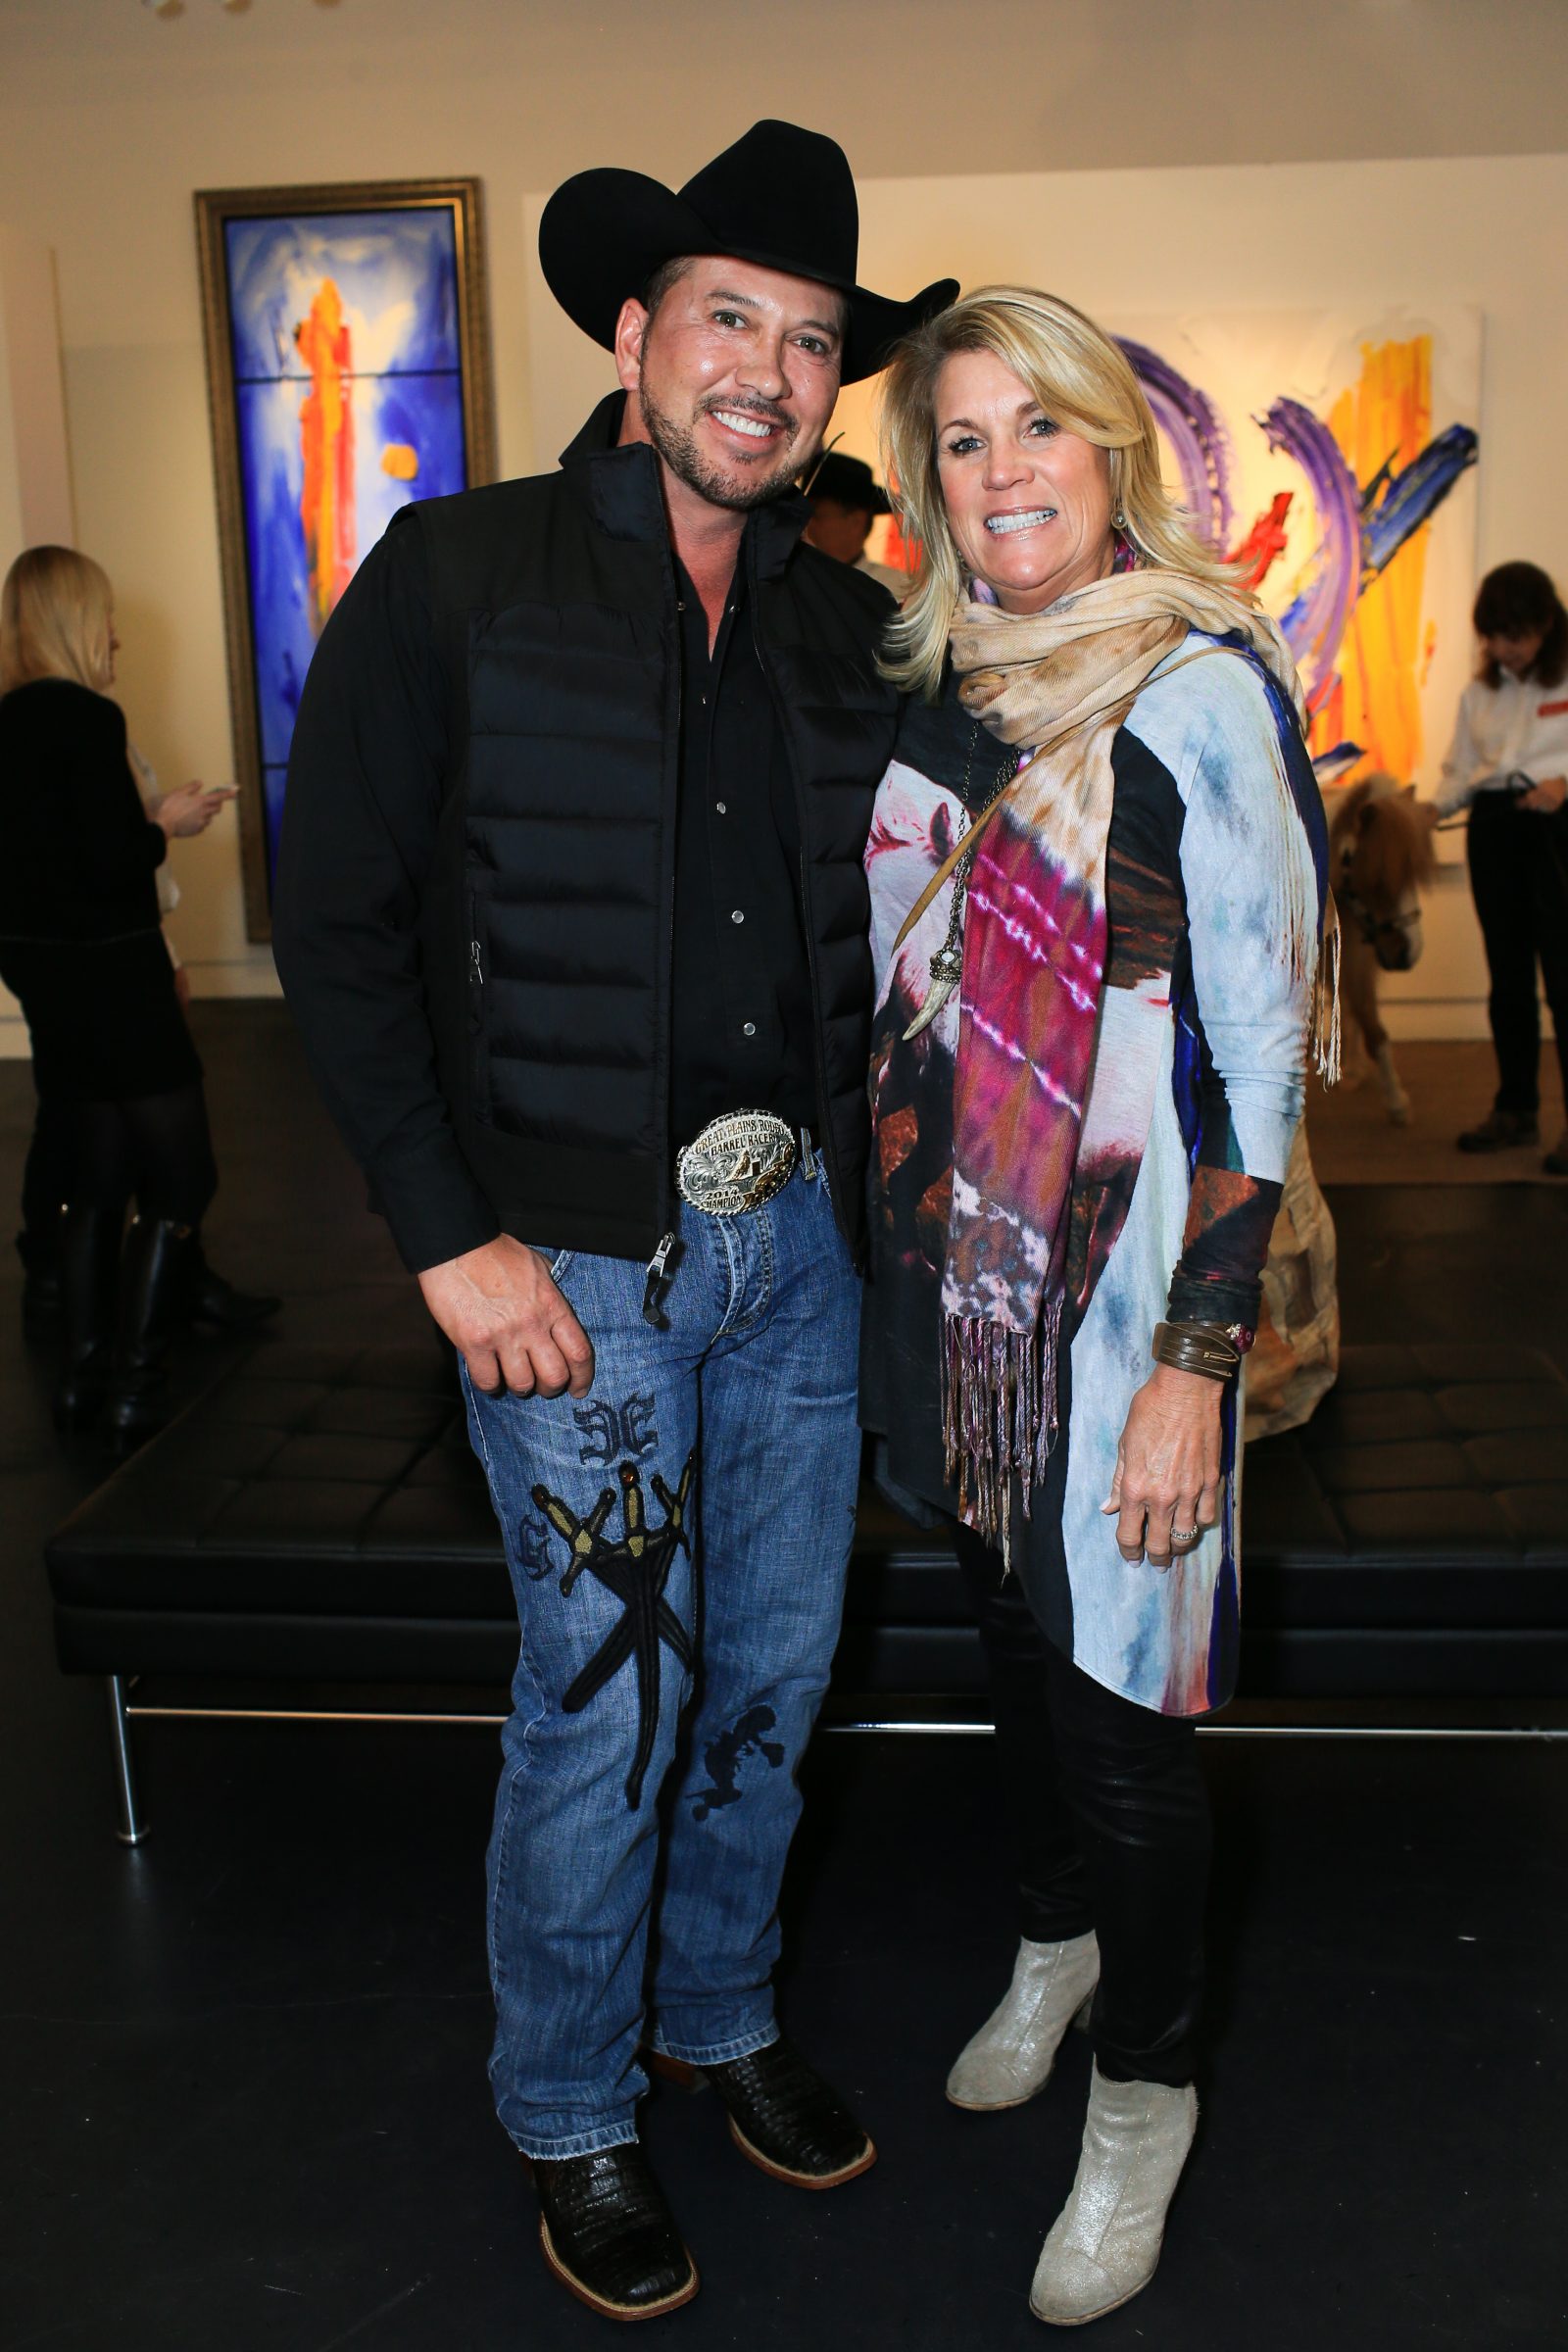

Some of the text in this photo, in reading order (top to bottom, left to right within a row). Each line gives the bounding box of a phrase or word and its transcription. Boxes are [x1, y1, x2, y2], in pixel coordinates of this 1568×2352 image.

[695, 1119, 784, 1154] GREAT PLAINS RODEO
[710, 1136, 746, 1155] BARREL
[701, 1195, 741, 1208] CHAMPION
[706, 1189, 738, 1200] 2014
